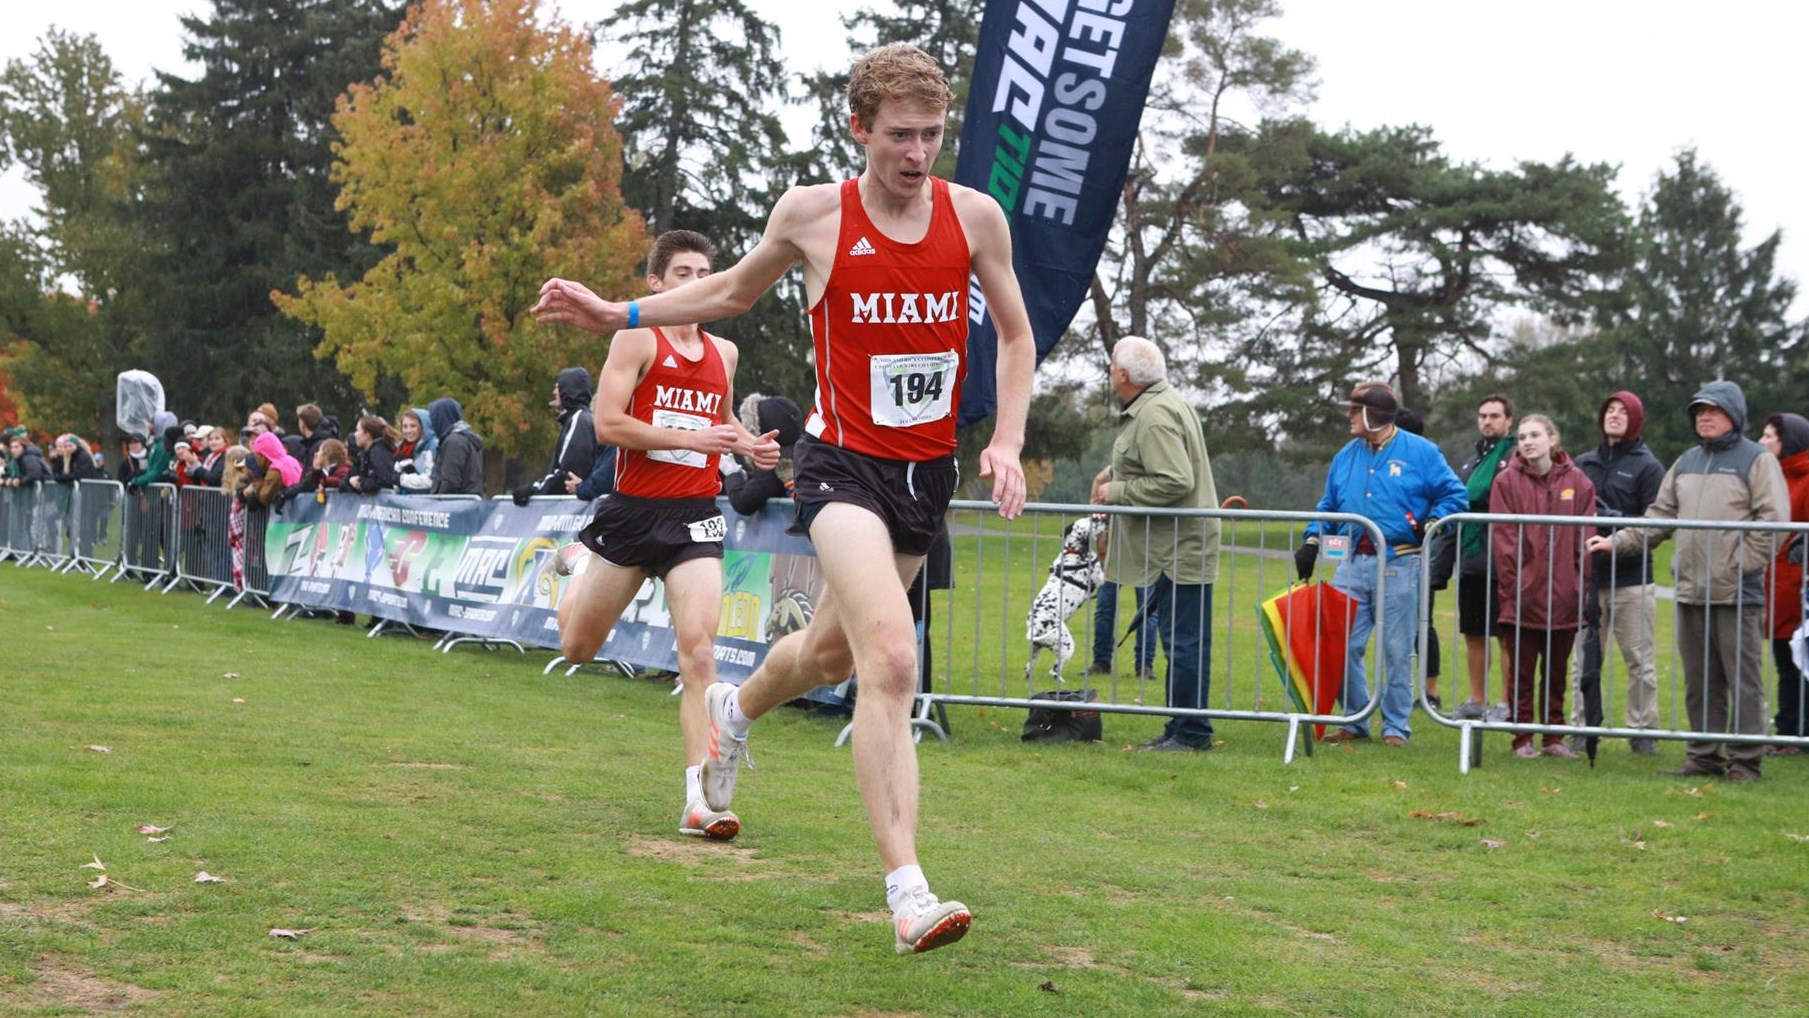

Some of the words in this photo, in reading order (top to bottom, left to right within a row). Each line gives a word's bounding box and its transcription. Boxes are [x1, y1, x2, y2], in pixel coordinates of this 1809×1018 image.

[850, 291, 960, 324] MIAMI
[653, 384, 722, 415] MIAMI
[890, 371, 942, 406] 194
[401, 508, 451, 529] CONFERENCE
[456, 547, 512, 587] MAC
